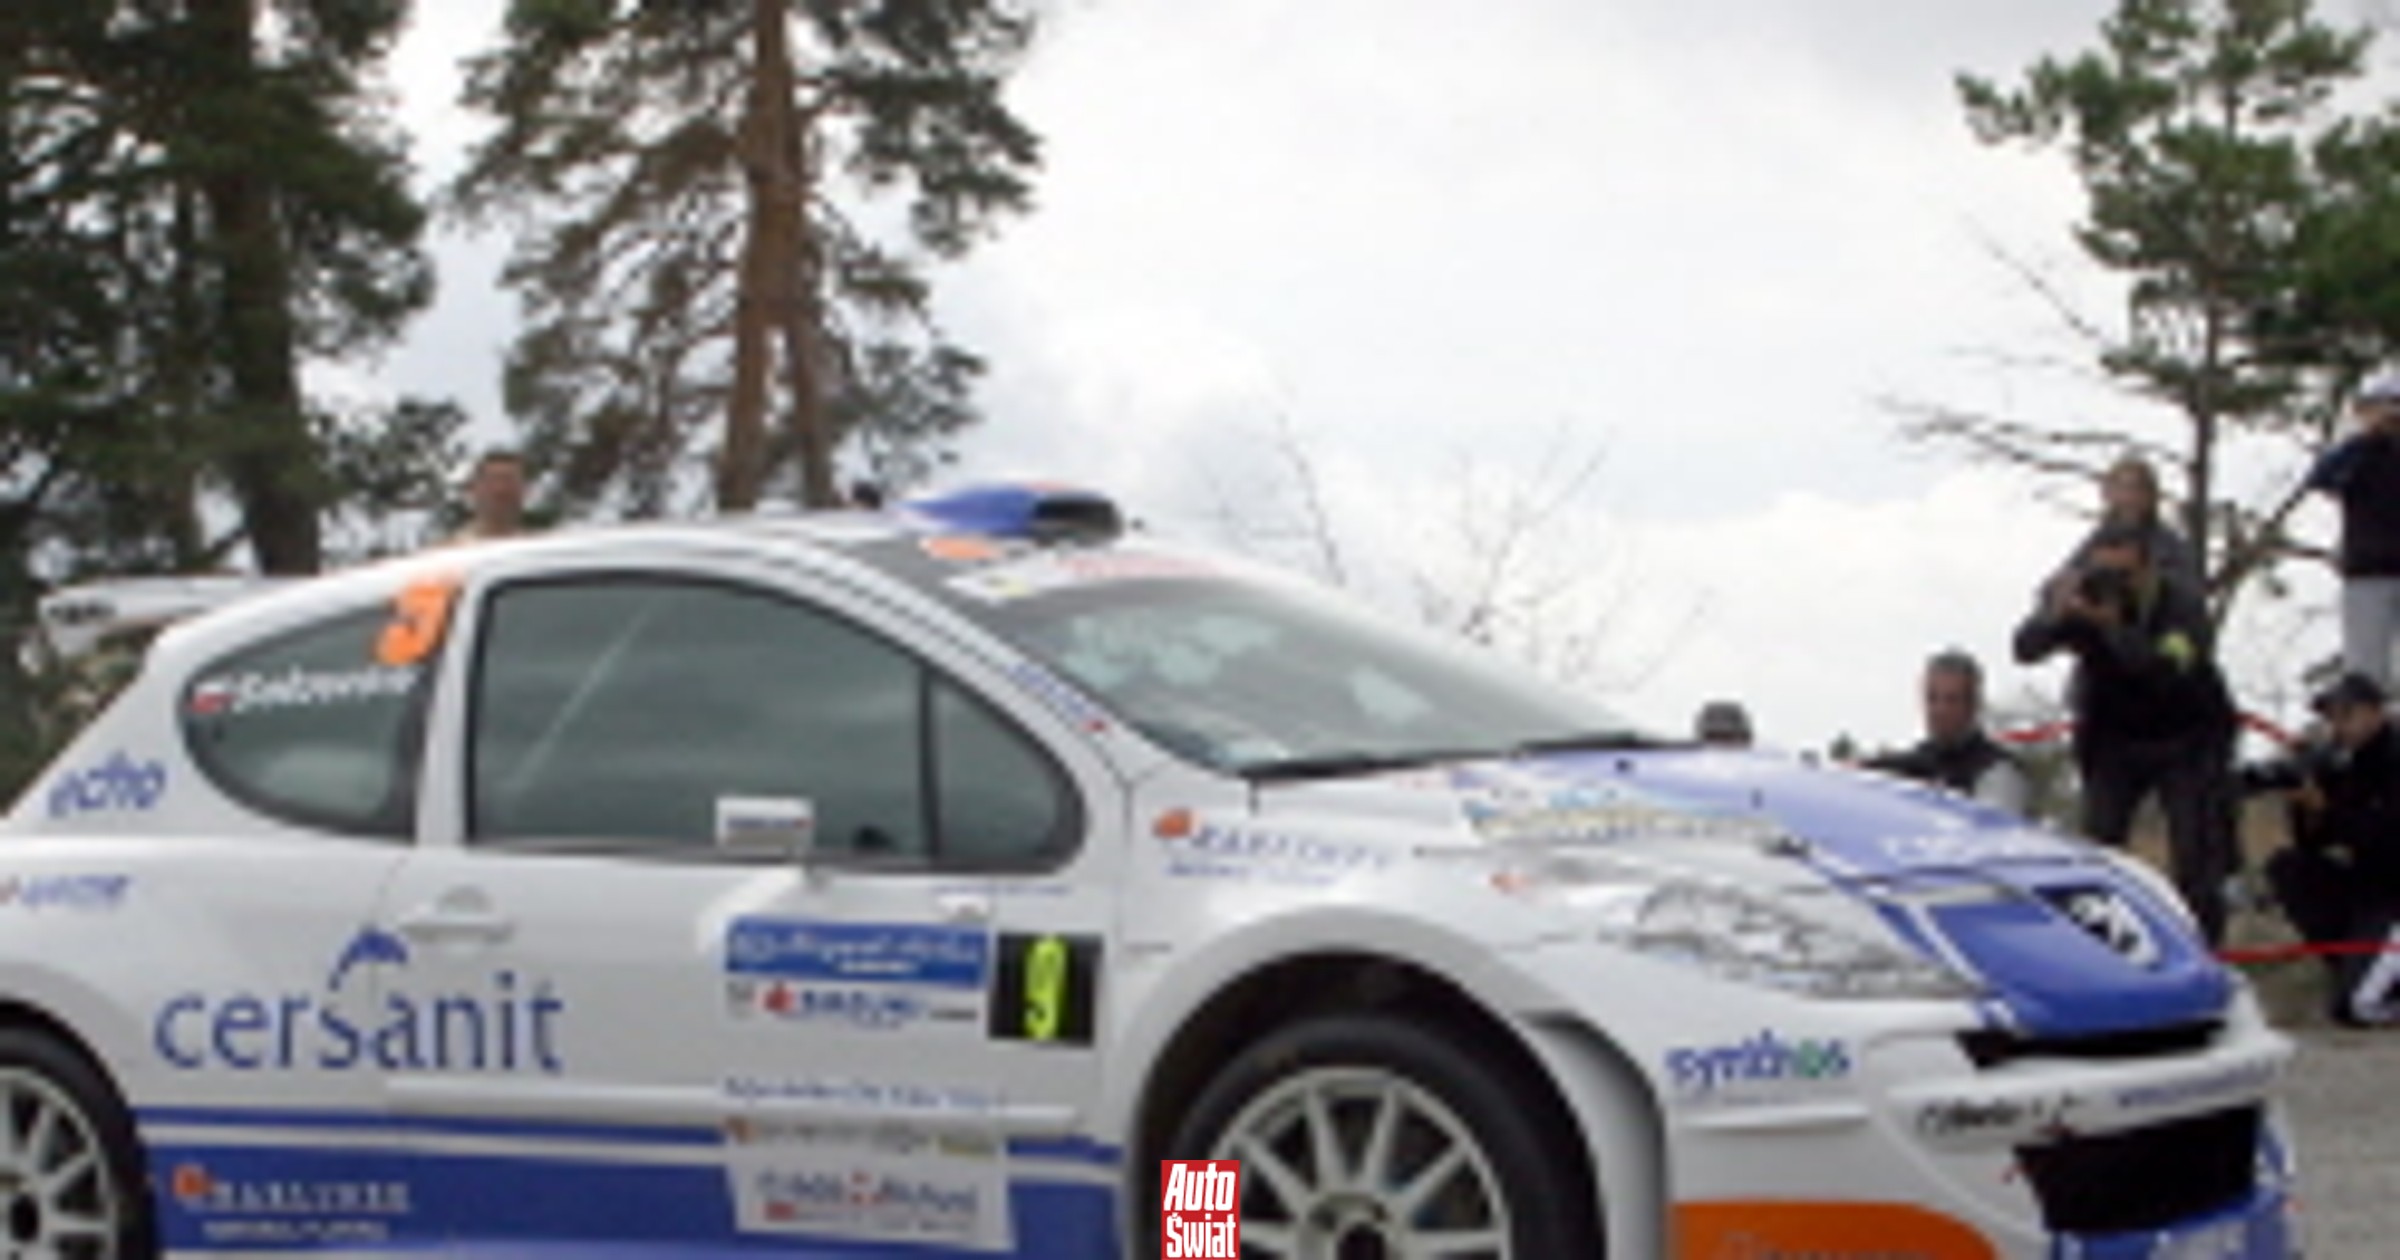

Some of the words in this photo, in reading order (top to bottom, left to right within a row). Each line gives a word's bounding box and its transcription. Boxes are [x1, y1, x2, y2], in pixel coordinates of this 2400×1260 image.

[48, 753, 166, 816] echo
[154, 968, 564, 1074] cersanit
[1666, 1029, 1851, 1090] synthos
